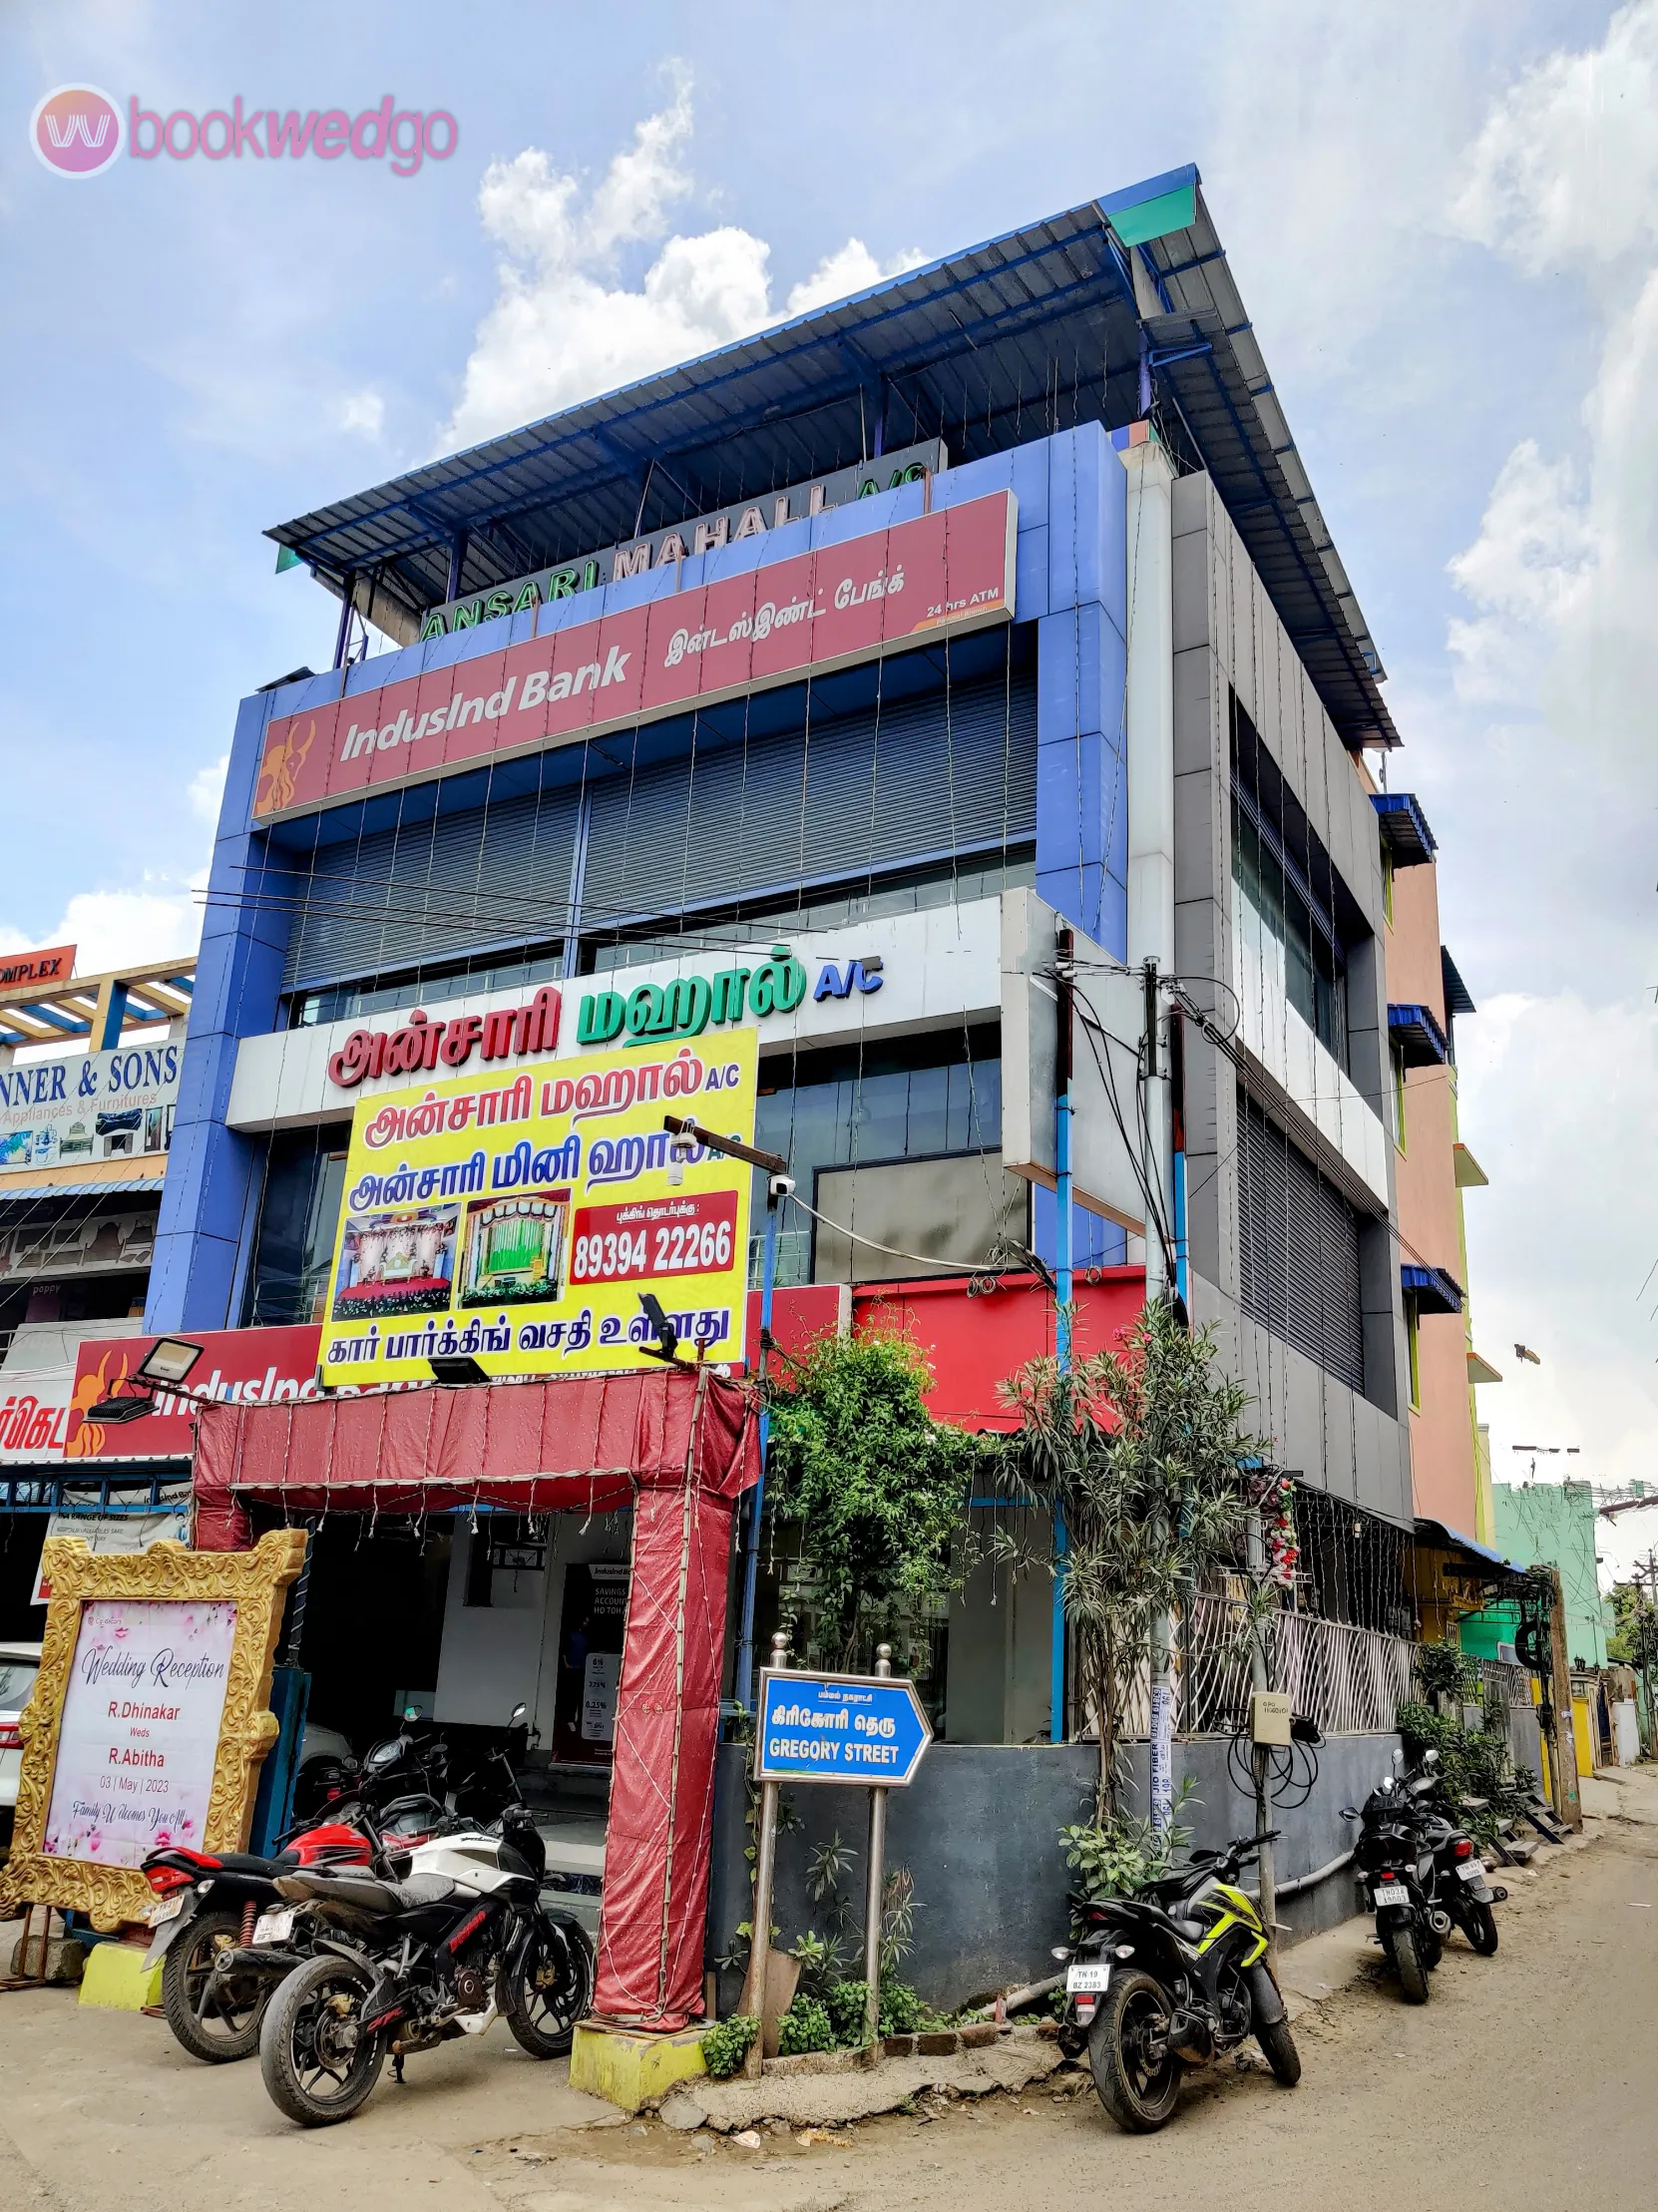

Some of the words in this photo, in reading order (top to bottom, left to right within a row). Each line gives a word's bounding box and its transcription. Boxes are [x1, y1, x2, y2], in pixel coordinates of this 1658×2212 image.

[420, 560, 601, 643] ANSARI
[613, 483, 839, 582] MAHALL
[926, 604, 943, 619] 24
[946, 599, 967, 612] hrs
[969, 587, 1000, 606] ATM
[339, 675, 518, 762] IndusInd
[517, 645, 632, 711] Bank
[813, 955, 885, 1003] A/C
[328, 986, 562, 1088] அன்சாரி
[576, 945, 807, 1049] மஹால்
[78, 1061, 98, 1098] &
[108, 1046, 179, 1094] SONS
[705, 1064, 740, 1092] A/C
[3, 1104, 73, 1127] Appliances
[77, 1100, 87, 1115] &
[90, 1092, 158, 1113] Furnitures
[365, 1075, 532, 1148] அன்சாரி
[541, 1048, 703, 1126] மஹால்
[349, 1151, 486, 1212] அன்சாரி
[491, 1134, 581, 1189] மினி
[574, 1229, 647, 1279] 89394
[652, 1220, 731, 1272] 22266
[32, 1283, 61, 1296] poppy
[327, 1325, 380, 1364] கார்
[385, 1314, 511, 1360] பார்க்கிங்
[519, 1309, 592, 1358] வசதி
[81, 1645, 147, 1689] Wedding
[150, 1647, 224, 1691] Reception
[108, 1701, 181, 1721] R.Dhinakar
[854, 1713, 896, 1739] தெரு
[130, 1726, 151, 1738] Weds
[109, 1747, 165, 1768] R.Abitha
[769, 1737, 840, 1762] GREGORY
[844, 1743, 900, 1765] STREET
[100, 1775, 112, 1789] 03
[119, 1776, 139, 1794] May
[146, 1778, 170, 1794] 2023
[72, 1800, 101, 1824] Family
[148, 1807, 169, 1832] You
